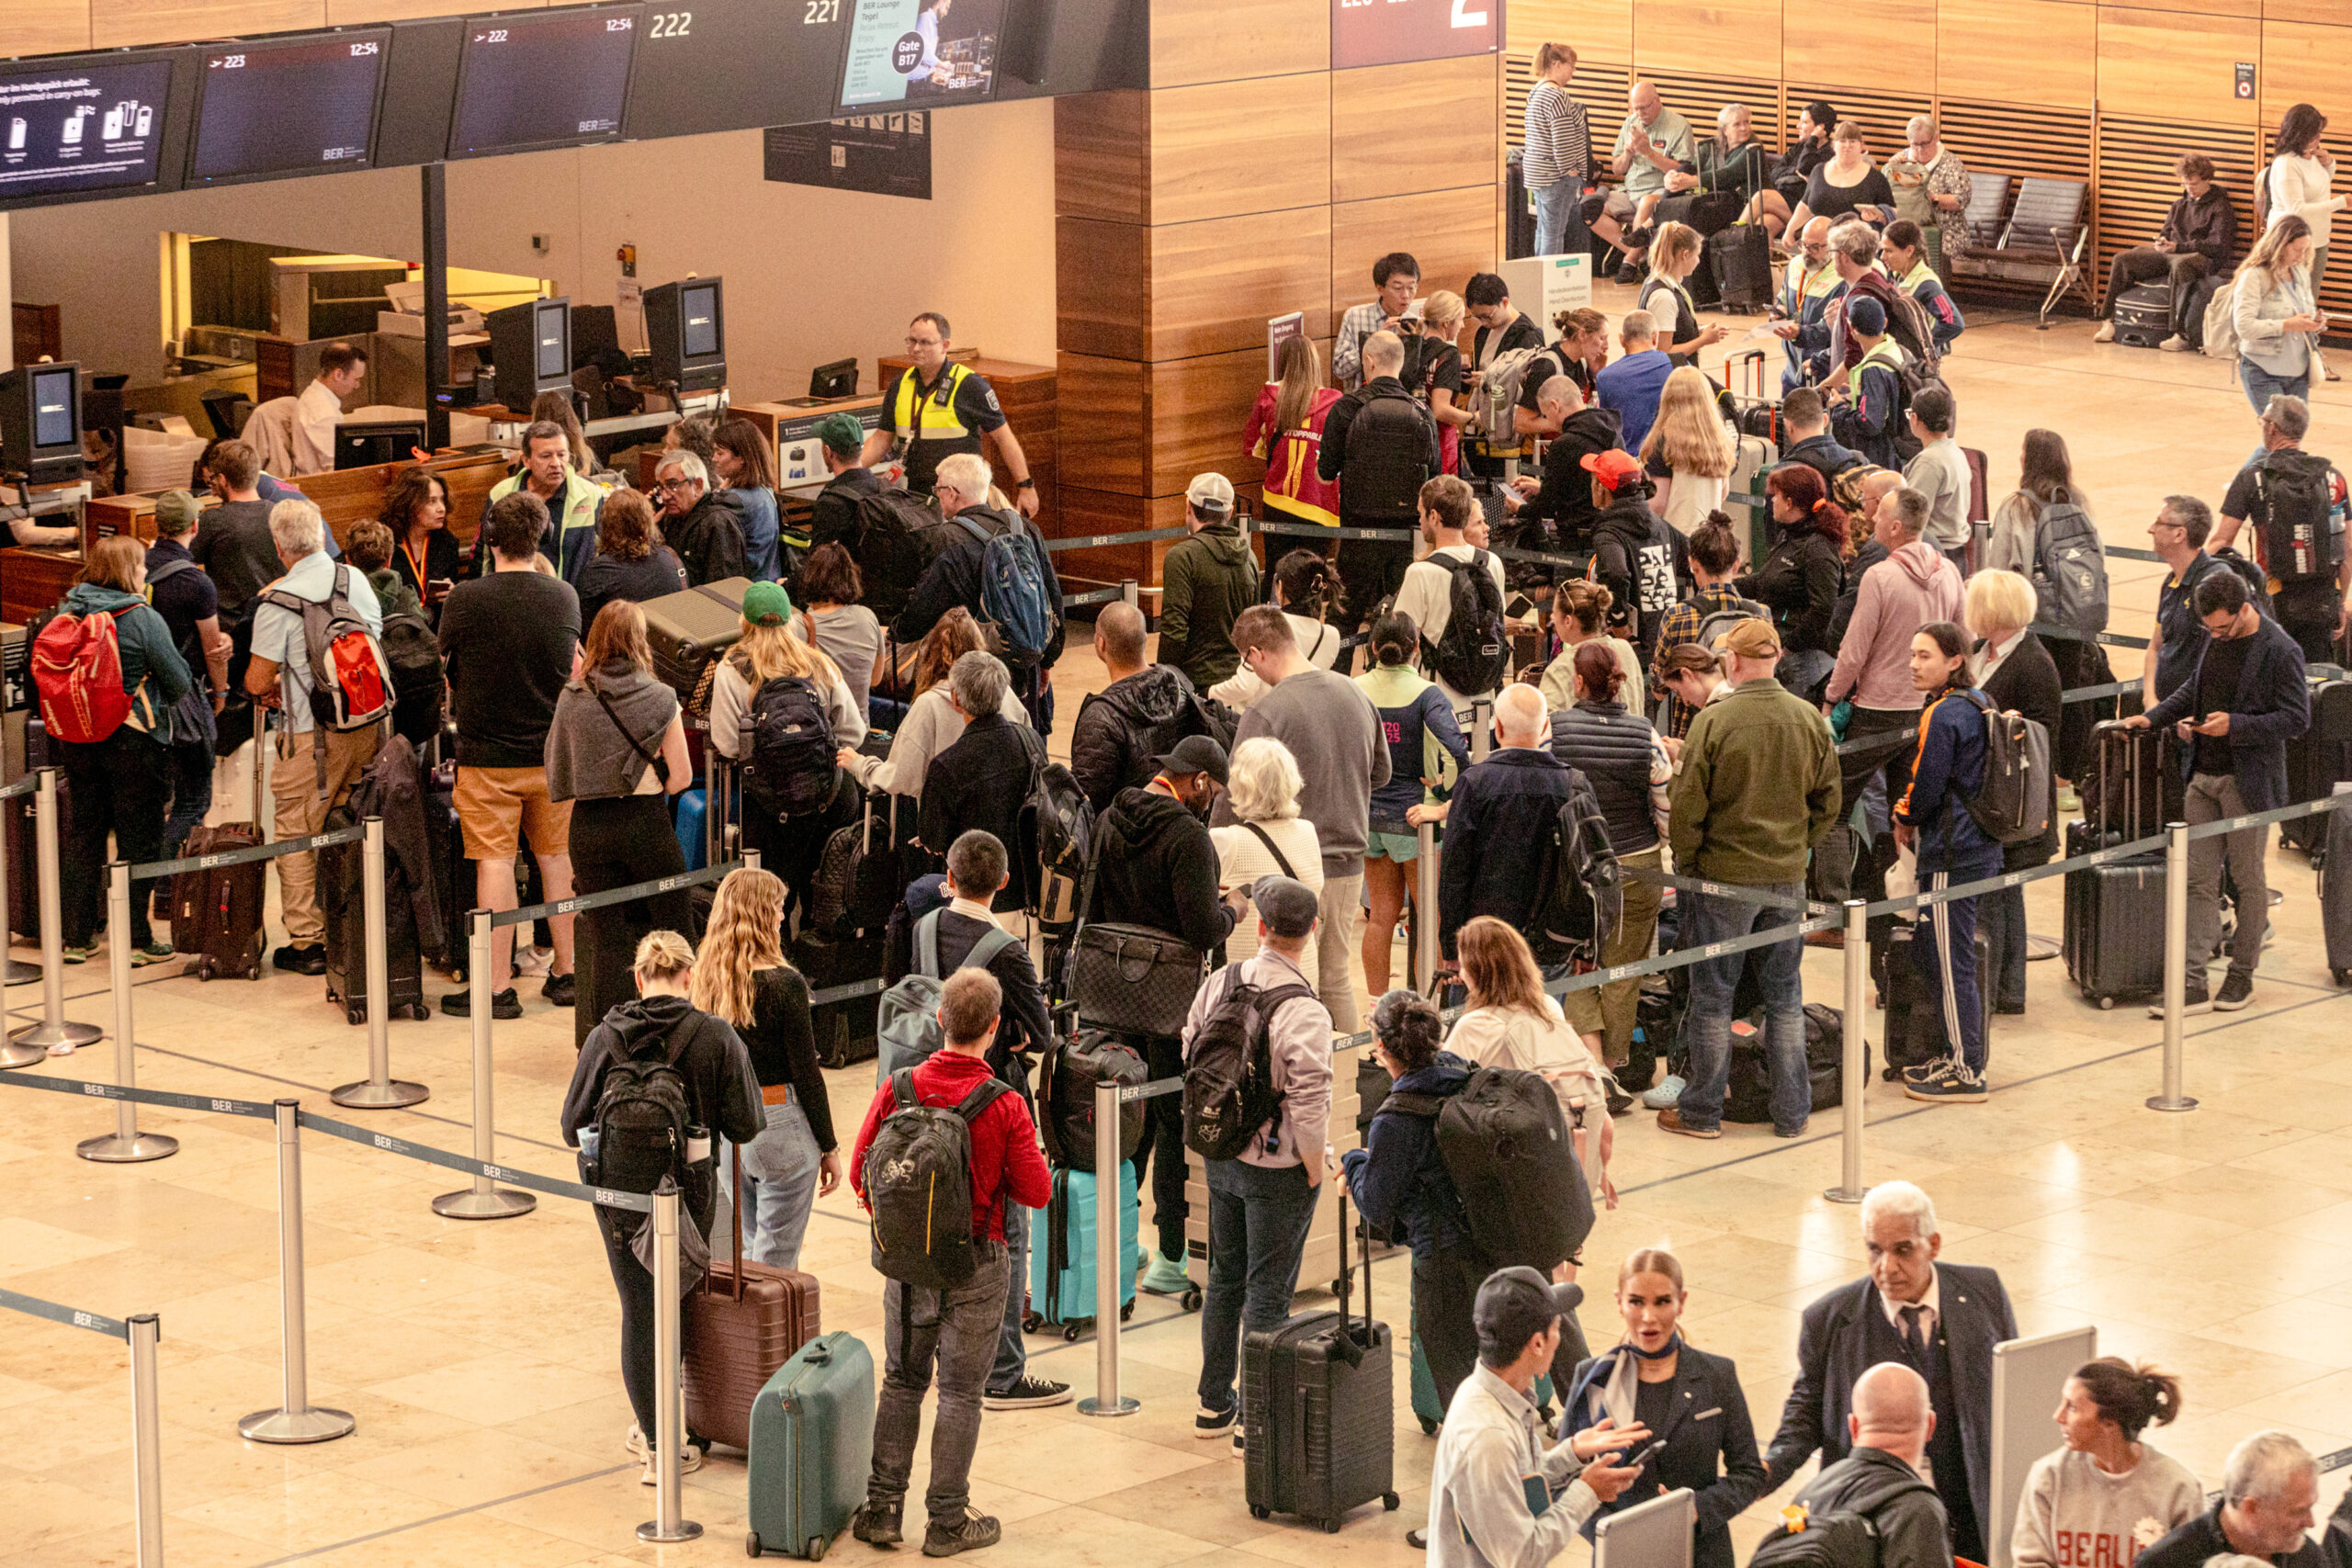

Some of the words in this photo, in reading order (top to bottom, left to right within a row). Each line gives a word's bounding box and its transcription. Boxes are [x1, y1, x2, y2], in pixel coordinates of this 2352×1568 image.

[803, 0, 839, 24] 221
[488, 30, 508, 42] 222
[606, 18, 632, 31] 12:54
[650, 12, 692, 38] 222
[899, 41, 920, 52] Gate
[224, 55, 245, 68] 223
[350, 43, 379, 56] 12:54
[899, 55, 916, 66] B17
[949, 78, 967, 90] BER
[578, 120, 598, 132] BER
[323, 147, 344, 160] BER
[1259, 522, 1276, 531] BER
[1360, 530, 1377, 538] BER
[1092, 536, 1108, 545] BER
[1075, 594, 1089, 604] BER
[1459, 712, 1473, 723] BER
[695, 719, 709, 730] BER
[311, 835, 329, 847] BER
[200, 855, 219, 868] BER
[2090, 852, 2104, 864] BER
[659, 879, 675, 891] BER
[2004, 874, 2019, 886] BER
[1702, 883, 1719, 895] BER
[1917, 894, 1931, 906] BER
[557, 901, 574, 914] BER
[1809, 902, 1826, 914] BER
[1799, 921, 1814, 934] BER
[1705, 944, 1721, 957] BER
[1609, 967, 1625, 980] BER
[1336, 1037, 1353, 1049] BER
[84, 1083, 105, 1097] BER
[1121, 1087, 1139, 1100] BER
[211, 1099, 232, 1113] BER
[374, 1134, 392, 1150] BER
[483, 1164, 501, 1179] BER
[596, 1189, 614, 1204] BER
[74, 1311, 92, 1327] BER
[2057, 1530, 2145, 1568] BERLI
